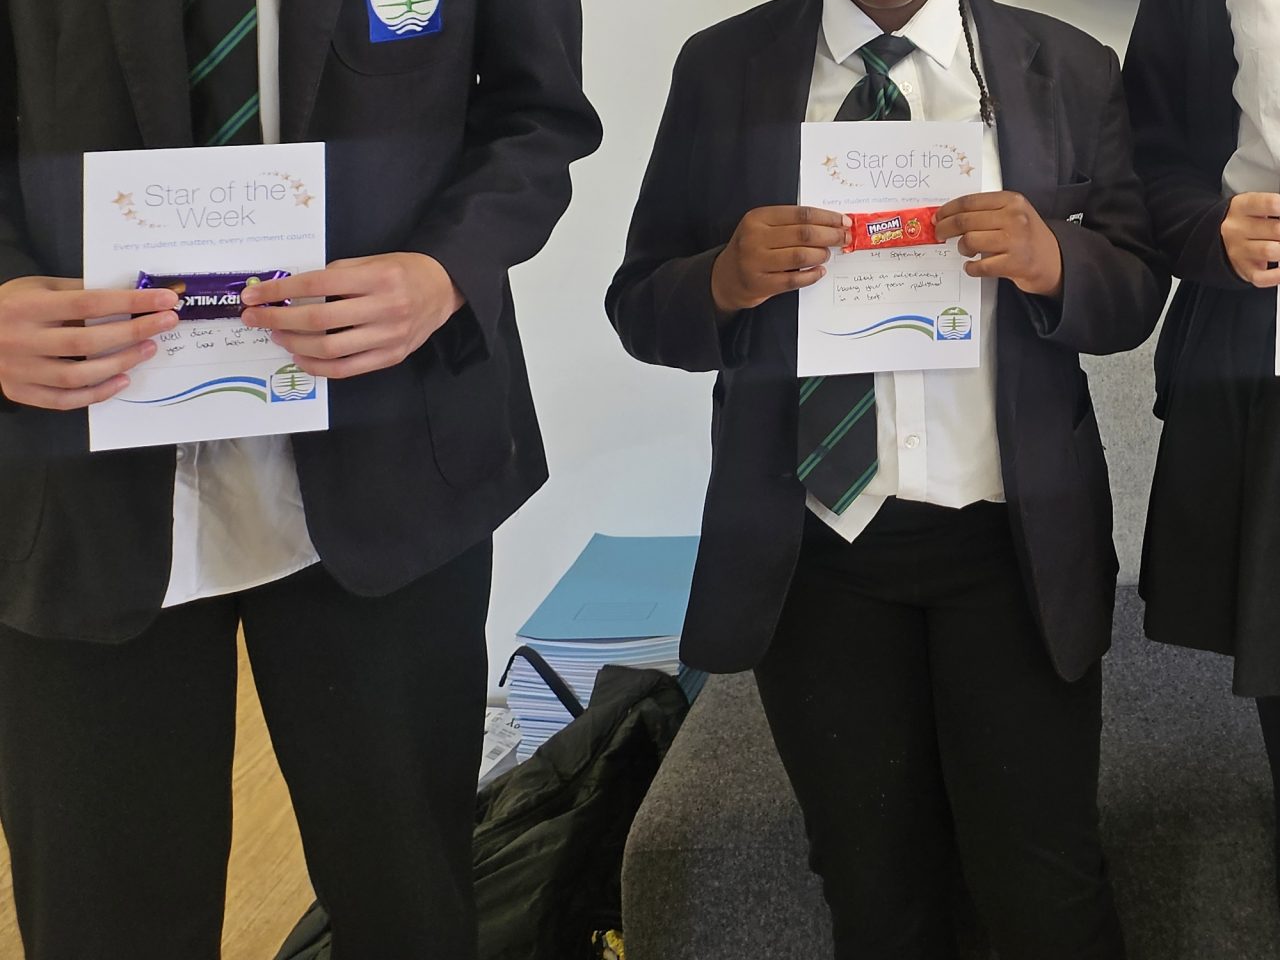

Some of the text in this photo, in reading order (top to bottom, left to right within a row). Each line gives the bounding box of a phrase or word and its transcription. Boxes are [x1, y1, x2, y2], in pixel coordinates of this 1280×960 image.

[846, 150, 954, 170] Star of the
[870, 170, 930, 189] Week
[144, 178, 287, 208] Star of the
[176, 205, 257, 230] Week
[869, 219, 899, 234] MAOAM
[113, 243, 139, 252] Every
[143, 240, 176, 249] student
[219, 237, 243, 246] every
[246, 233, 283, 243] moment
[286, 232, 316, 241] counts
[185, 294, 241, 306] IRY MILK
